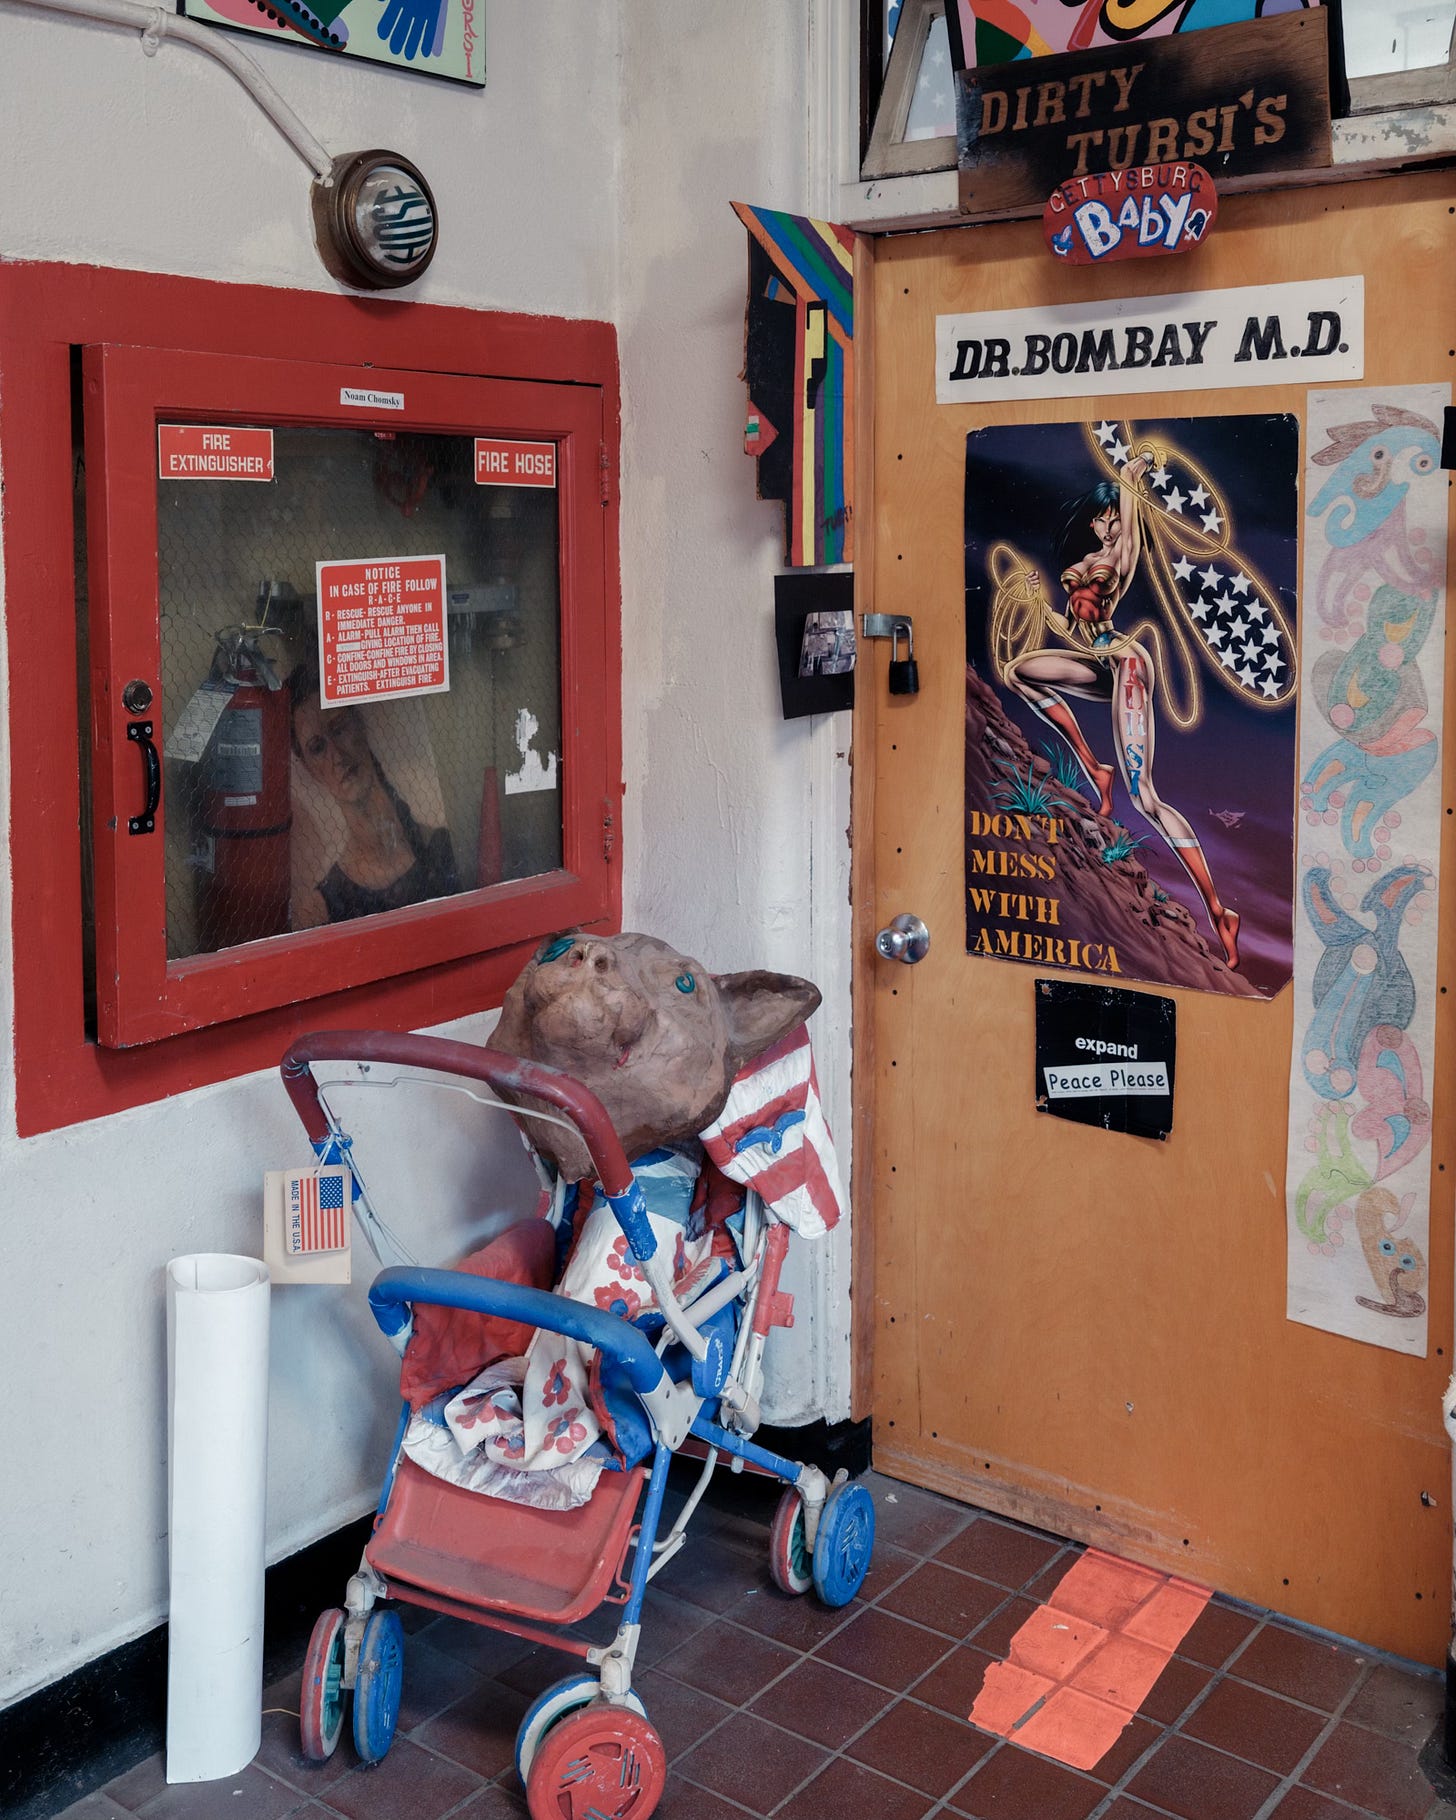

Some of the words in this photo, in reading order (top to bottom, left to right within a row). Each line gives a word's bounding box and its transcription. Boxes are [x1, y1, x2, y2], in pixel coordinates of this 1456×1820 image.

[978, 63, 1146, 136] DIRTY
[1066, 88, 1288, 176] TURSI'S
[1234, 311, 1350, 363] M.D.
[345, 391, 366, 401] Noam
[367, 393, 401, 408] Chomsky
[202, 433, 231, 450] FIRE
[169, 454, 264, 473] EXTINGUISHER
[478, 450, 509, 473] FIRE
[515, 452, 552, 476] HOSE
[365, 566, 401, 580] NOTICE
[329, 584, 339, 598] IN
[342, 583, 366, 597] CASE
[368, 582, 379, 595] OF
[382, 580, 402, 593] FIRE
[405, 577, 438, 592] FOLLOW
[367, 605, 394, 617] RESCUE
[396, 602, 422, 615] ANYONE
[425, 602, 433, 612] IN
[337, 617, 375, 631] IMMEDIATE
[377, 615, 406, 627] DANGER.
[383, 625, 405, 638] ALARM
[406, 623, 423, 636] THEN
[423, 622, 440, 633] CALL
[360, 638, 382, 650] GIVING
[384, 634, 415, 648] LOCATION
[415, 632, 424, 643] OF
[394, 645, 409, 657] FIRE
[409, 644, 418, 655] BY
[418, 641, 443, 654] CLOSING
[336, 662, 348, 674] ALL
[349, 659, 372, 672] DOORS
[373, 657, 387, 669] AND
[387, 654, 417, 668] WINDOWS
[418, 653, 425, 664] IN
[401, 662, 439, 676] EVACUATING
[336, 681, 371, 696] PATIENTS.
[376, 674, 416, 690] EXTINGUISH
[969, 810, 1065, 844] DON'T
[971, 849, 1057, 881] MESS
[968, 887, 1060, 926] WITH
[974, 927, 1123, 973] AMERICA
[1075, 1037, 1138, 1060] expand
[1049, 1073, 1102, 1090] Peace
[1110, 1068, 1166, 1088] Please
[291, 1180, 299, 1201] MADE
[292, 1215, 300, 1229] THE
[292, 1232, 301, 1253] U.S.A.
